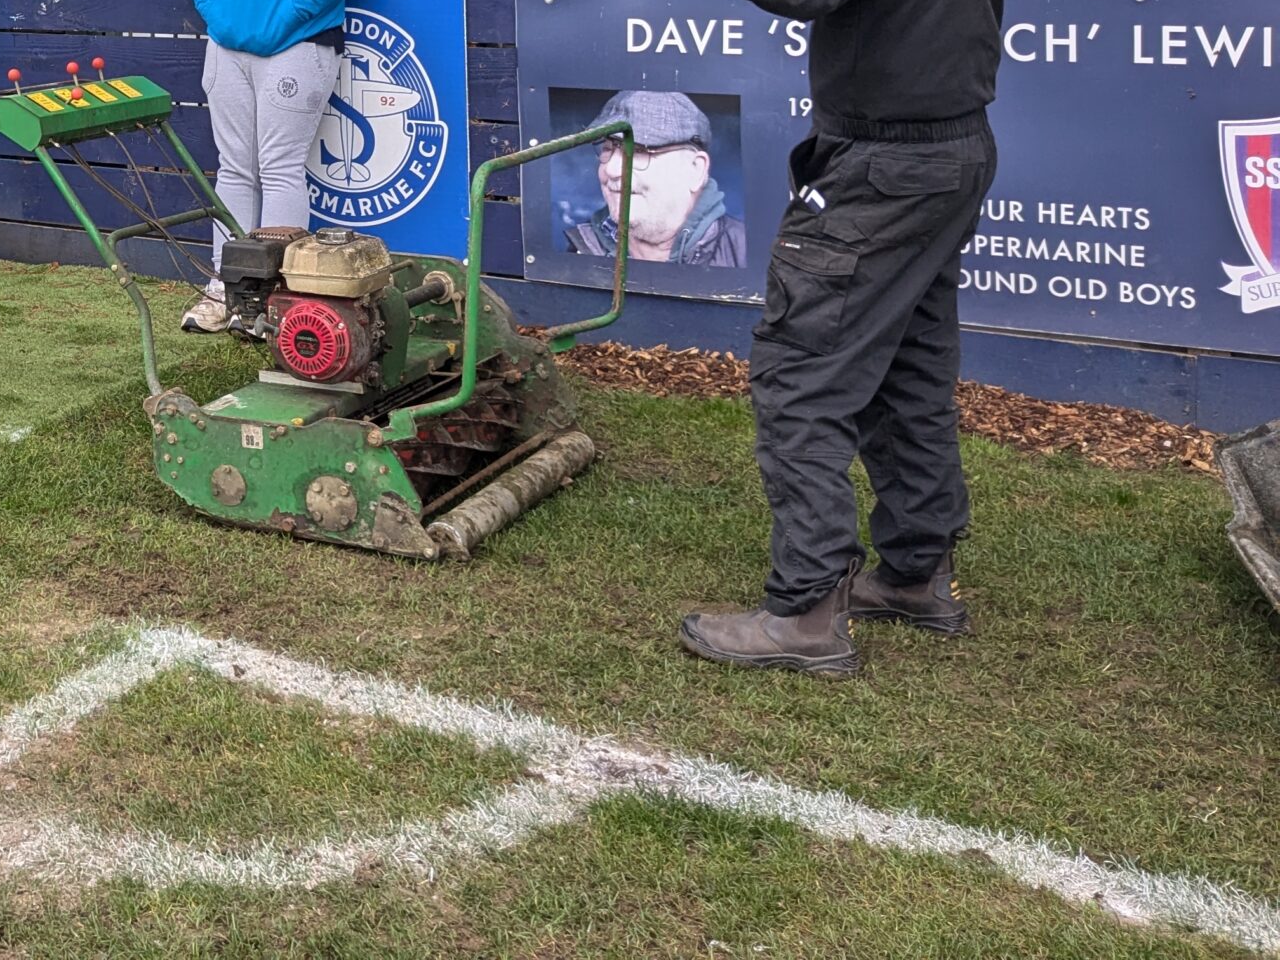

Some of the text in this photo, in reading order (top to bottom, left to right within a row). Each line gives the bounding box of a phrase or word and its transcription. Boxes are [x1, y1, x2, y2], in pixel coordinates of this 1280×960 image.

[626, 17, 744, 56] DAVE
[1132, 24, 1273, 69] LEWI
[380, 96, 396, 107] 92
[788, 97, 813, 117] 19
[979, 198, 1151, 231] UR HEARTS
[1048, 275, 1108, 301] OLD
[1119, 281, 1197, 310] BOYS
